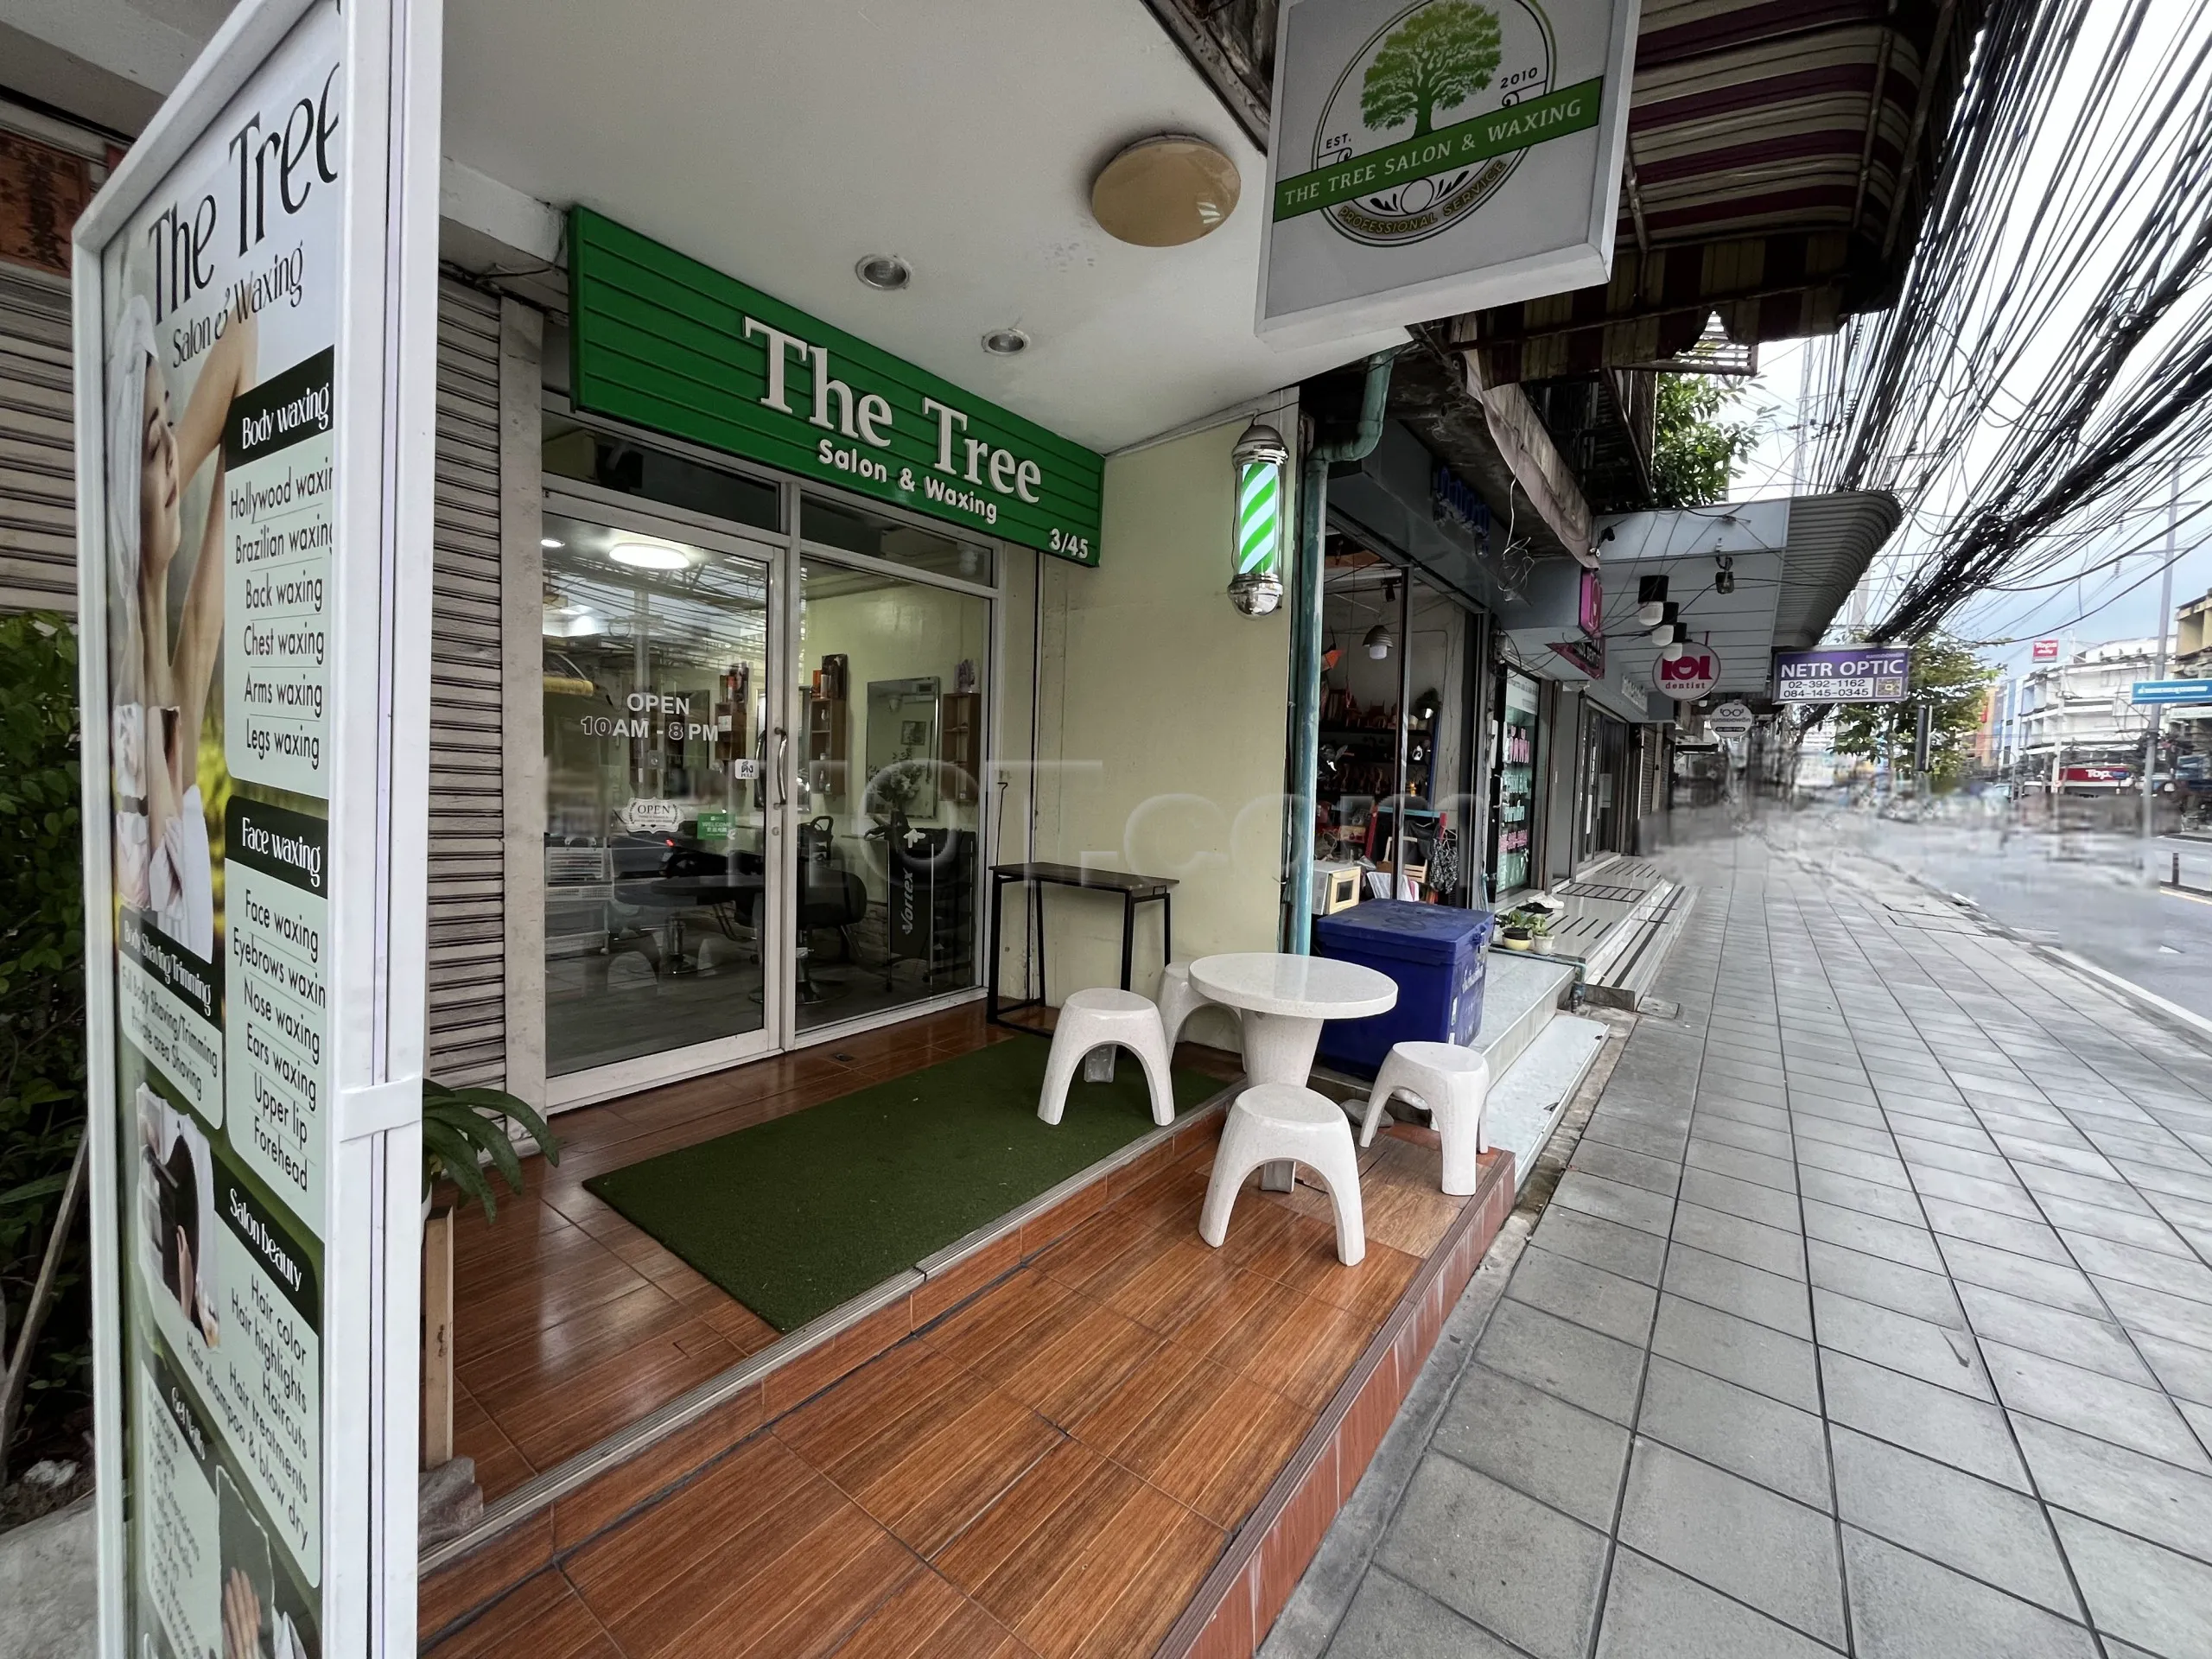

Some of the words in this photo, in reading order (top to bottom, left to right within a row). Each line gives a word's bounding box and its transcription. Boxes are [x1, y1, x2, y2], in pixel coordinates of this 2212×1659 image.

[1501, 67, 1538, 89] 2010
[1285, 181, 1319, 207] THE
[1328, 164, 1376, 194] TREE
[1384, 140, 1452, 175] SALON
[1461, 133, 1476, 150] &
[1487, 99, 1582, 143] WAXING
[1325, 135, 1352, 149] EST.
[148, 194, 215, 327] The
[229, 62, 340, 257] Tree
[1338, 206, 1438, 235] PROFESSIONAL
[1443, 159, 1507, 216] SERVICE
[173, 321, 211, 368] Salon
[234, 239, 303, 326] Waxing
[242, 409, 274, 450] Body
[276, 381, 330, 430] waxing
[742, 315, 893, 448] The
[922, 397, 1042, 504] Tree
[231, 466, 291, 524] Hollywood
[818, 439, 887, 484] Salon
[899, 467, 916, 491] &
[923, 475, 998, 525] Waxing
[236, 524, 284, 564] Brazilian
[1049, 527, 1089, 559] 3/45
[245, 571, 273, 609] Back
[276, 569, 323, 612] waxing
[244, 620, 275, 657] Chest
[277, 621, 324, 664] waxing
[1781, 662, 1833, 678] NETR
[1840, 659, 1904, 677] OPTIC
[244, 674, 273, 705] Arms
[276, 674, 323, 719] waxing
[626, 693, 690, 715] OPEN
[1665, 681, 1706, 690] dentist
[1783, 688, 1869, 698] 084-145-0345
[1788, 678, 1866, 689] 02-392-1162
[246, 719, 271, 760] Legs
[275, 723, 321, 770] waxing
[2085, 768, 2113, 780] Top
[638, 804, 671, 814] OPEN
[241, 817, 270, 855] Face
[272, 831, 321, 888] waxing
[233, 926, 284, 983] Eyebrows
[245, 888, 270, 928] Face
[275, 915, 318, 963] waxing
[244, 976, 272, 1020] Nose
[276, 1004, 321, 1065] waxing
[172, 1045, 201, 1101] Shaving
[247, 1022, 270, 1065] Ears
[272, 1052, 316, 1111] waxing
[254, 1071, 289, 1123] Upper
[293, 1101, 308, 1150] lip
[254, 1116, 308, 1192] Forehead
[230, 1188, 260, 1244] Salon
[261, 1224, 302, 1292] beauty
[231, 1287, 251, 1336] Hair
[255, 1319, 307, 1414] highlights
[251, 1274, 274, 1325] Hair
[276, 1319, 307, 1371] color
[187, 1331, 204, 1374] Hair
[206, 1363, 245, 1444] shampoo
[249, 1430, 257, 1464] &
[259, 1445, 285, 1507] blow
[289, 1497, 308, 1551] dry
[230, 1361, 249, 1410] Hair
[252, 1400, 308, 1503] treatments
[263, 1371, 308, 1459] Haircuts
